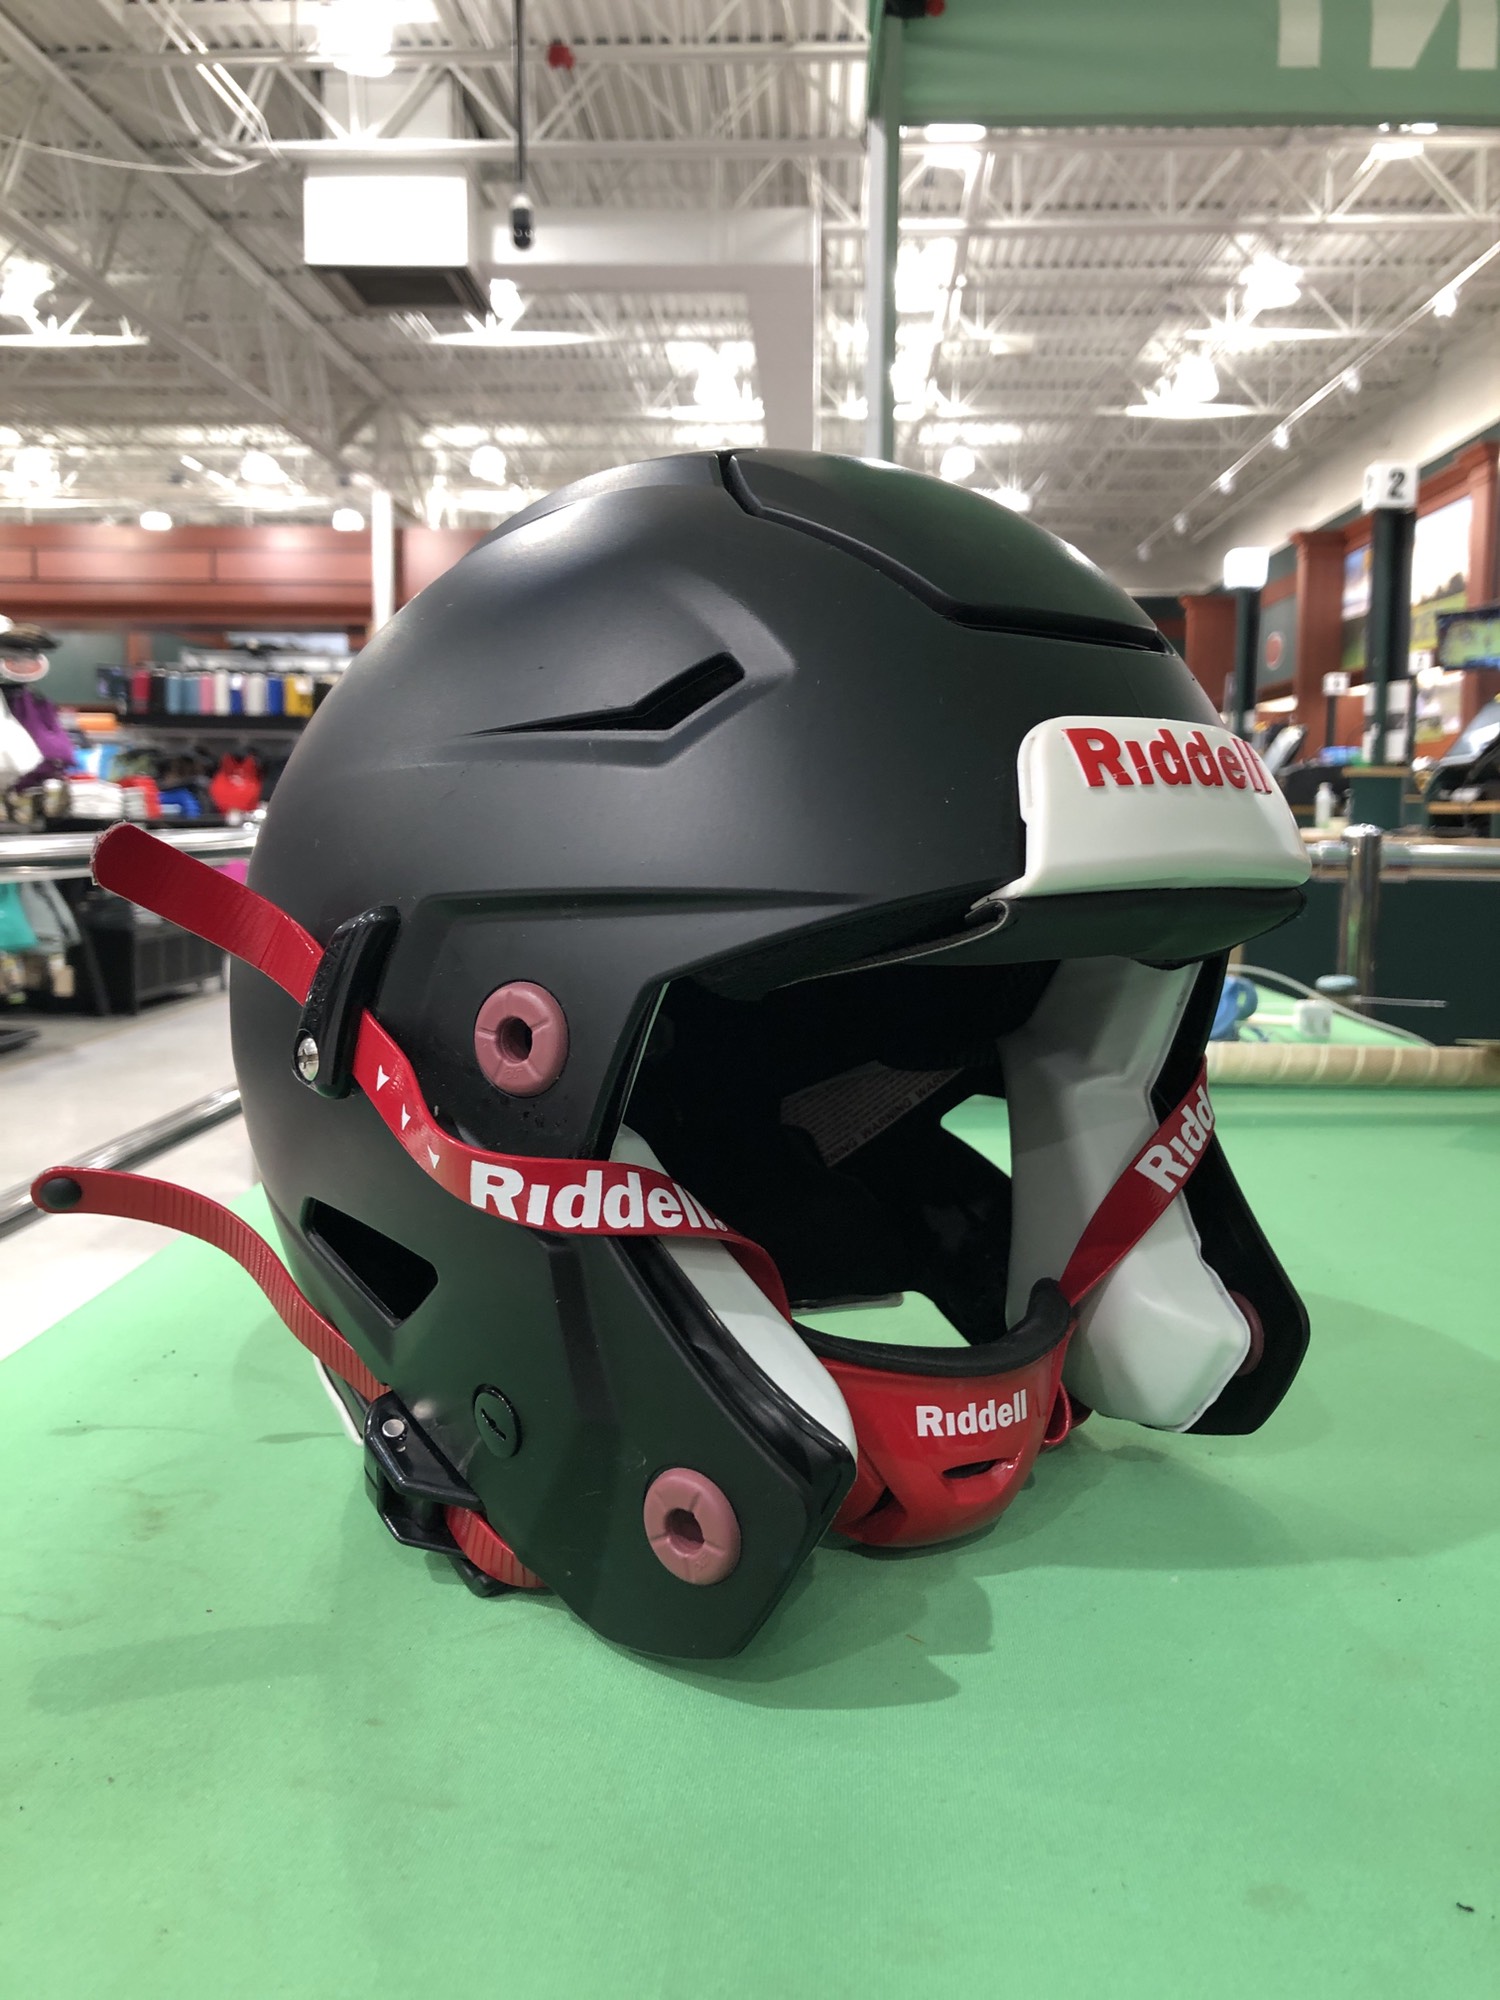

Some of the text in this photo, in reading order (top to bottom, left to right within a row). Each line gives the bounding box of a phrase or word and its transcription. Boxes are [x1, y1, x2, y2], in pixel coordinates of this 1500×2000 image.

[1387, 471, 1406, 499] 2
[1062, 728, 1272, 794] Riddell
[861, 1097, 912, 1139] WARNING
[470, 1160, 719, 1229] Riddell
[916, 1389, 1027, 1437] Riddell
